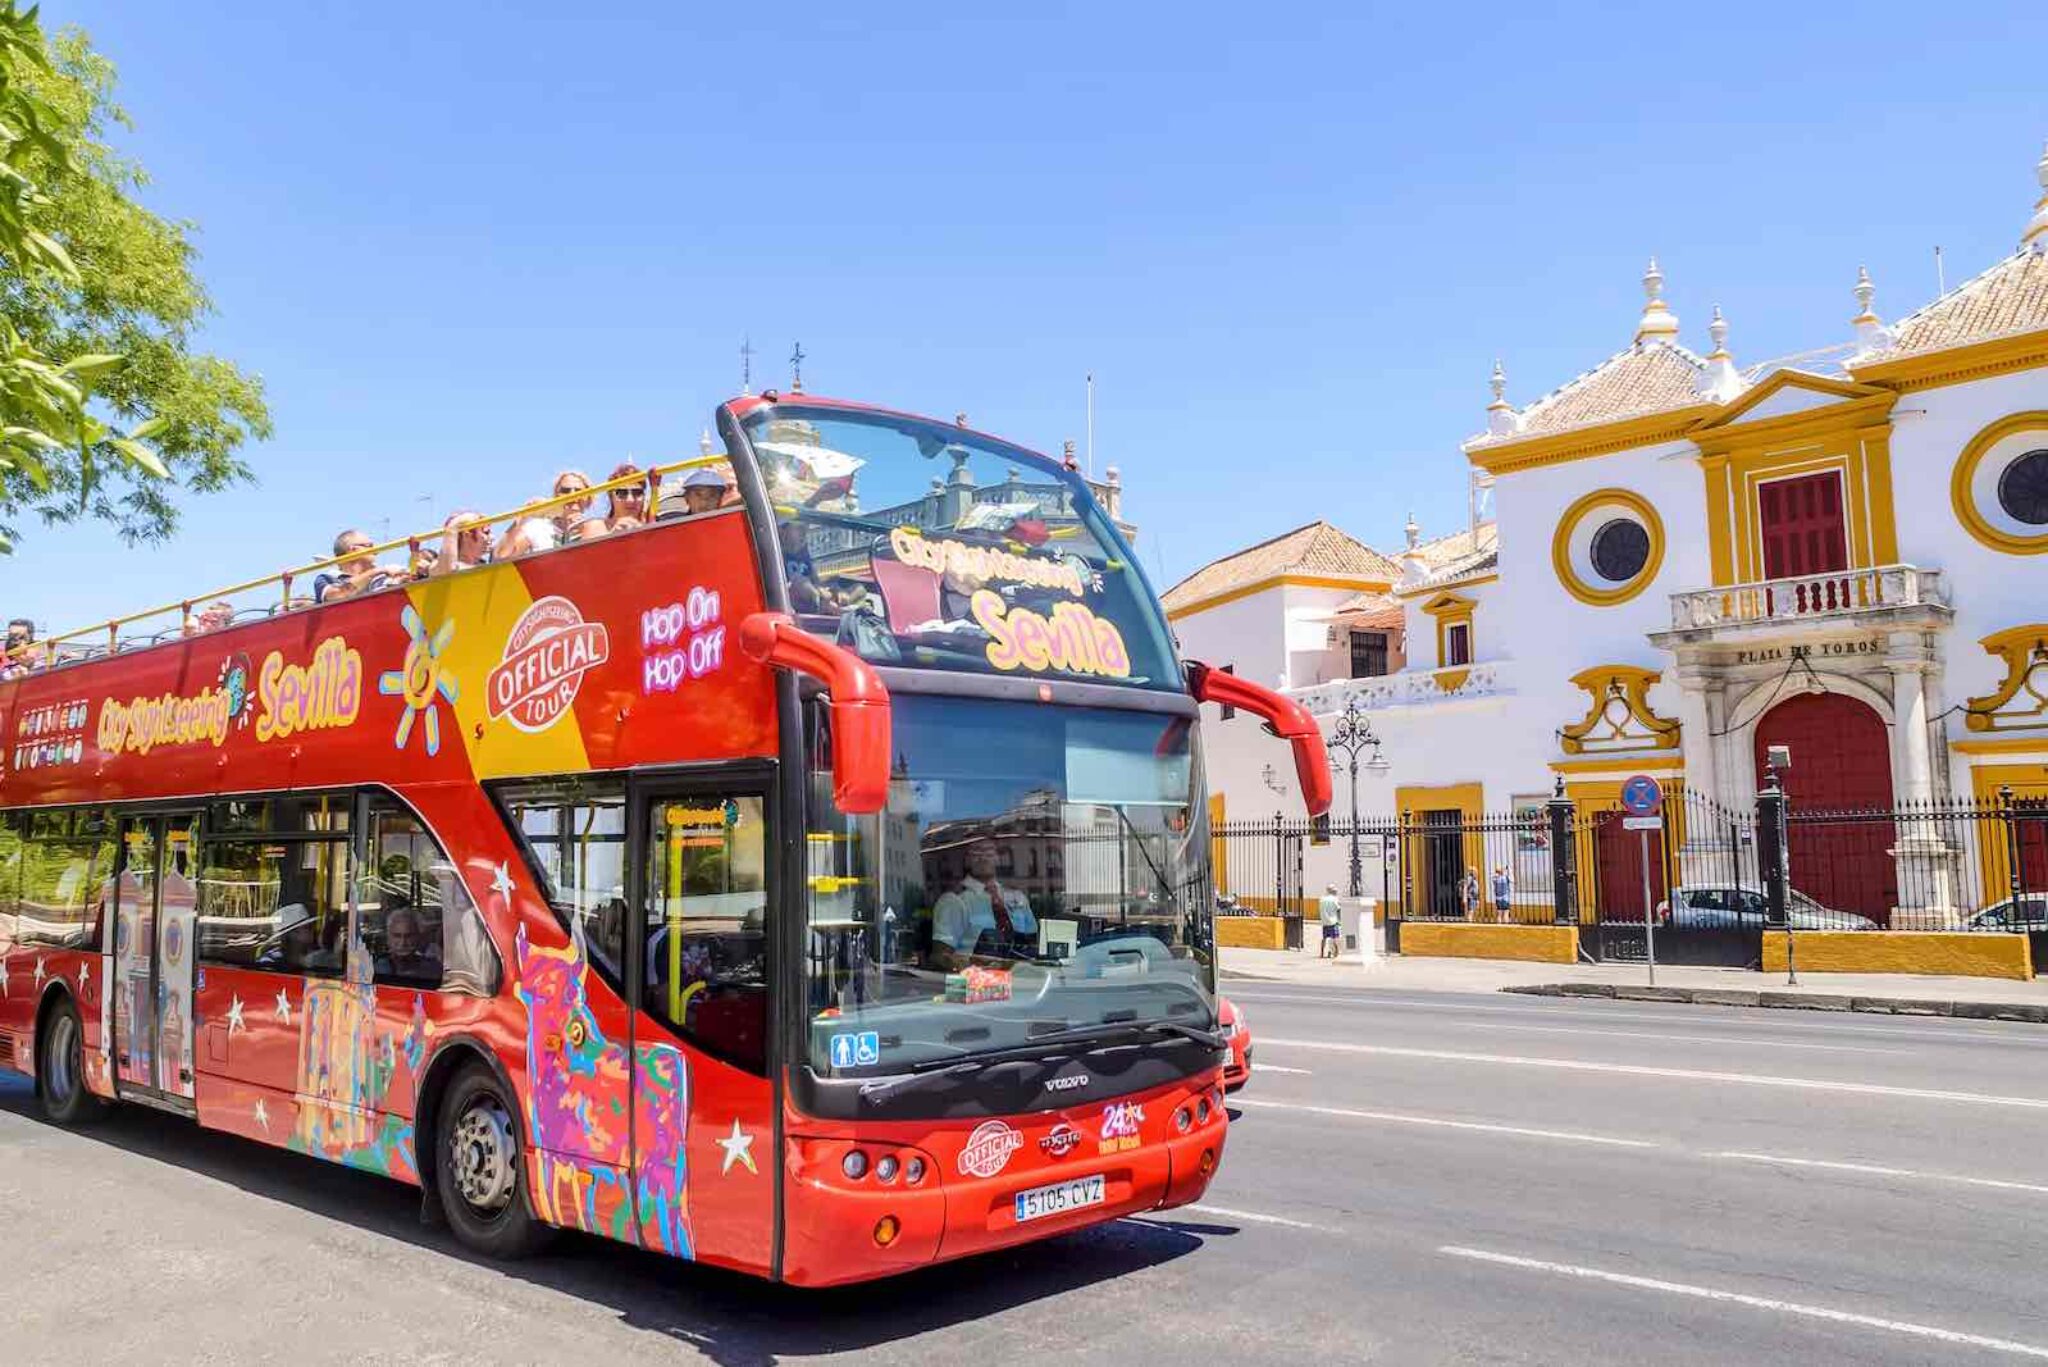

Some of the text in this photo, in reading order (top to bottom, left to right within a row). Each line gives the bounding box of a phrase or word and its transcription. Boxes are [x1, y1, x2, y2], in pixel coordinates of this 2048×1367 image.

[687, 587, 720, 630] On
[687, 626, 726, 677] Off
[971, 588, 1131, 678] Sevilla
[1738, 640, 1878, 663] PLAZA DE TOROS
[497, 630, 601, 706] OFFICIAL
[256, 636, 362, 742] Sevilla
[526, 681, 574, 721] TOUR
[1045, 1074, 1089, 1091] VOLVO
[963, 1133, 1020, 1168] OFFICIAL
[981, 1152, 1009, 1172] TOUR
[1028, 1179, 1101, 1214] 5105 CVZ
